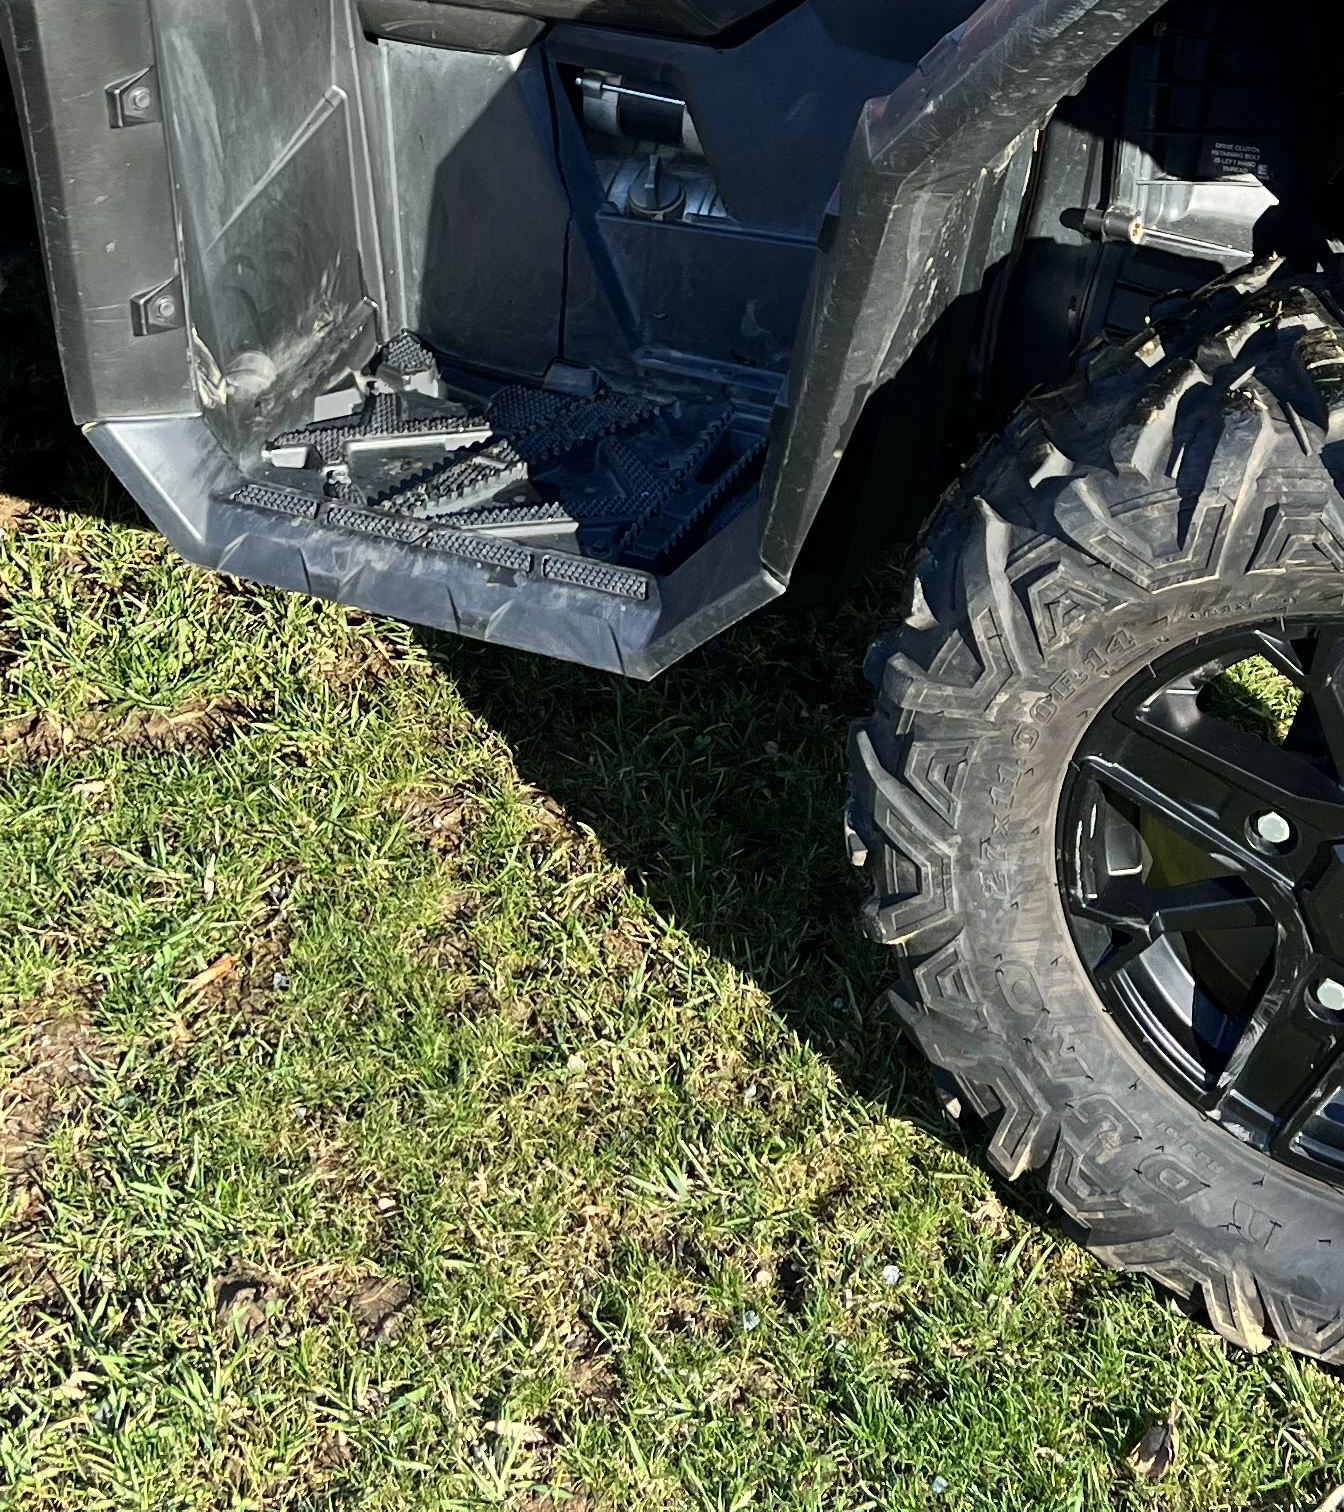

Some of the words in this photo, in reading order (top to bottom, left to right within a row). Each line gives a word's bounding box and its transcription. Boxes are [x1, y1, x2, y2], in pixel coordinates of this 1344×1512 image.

[1235, 144, 1260, 152] CLUTCH
[1211, 149, 1243, 158] RETAINING
[1237, 160, 1256, 168] HAND
[1222, 165, 1249, 174] THREAD
[994, 960, 1212, 1204] DURO
